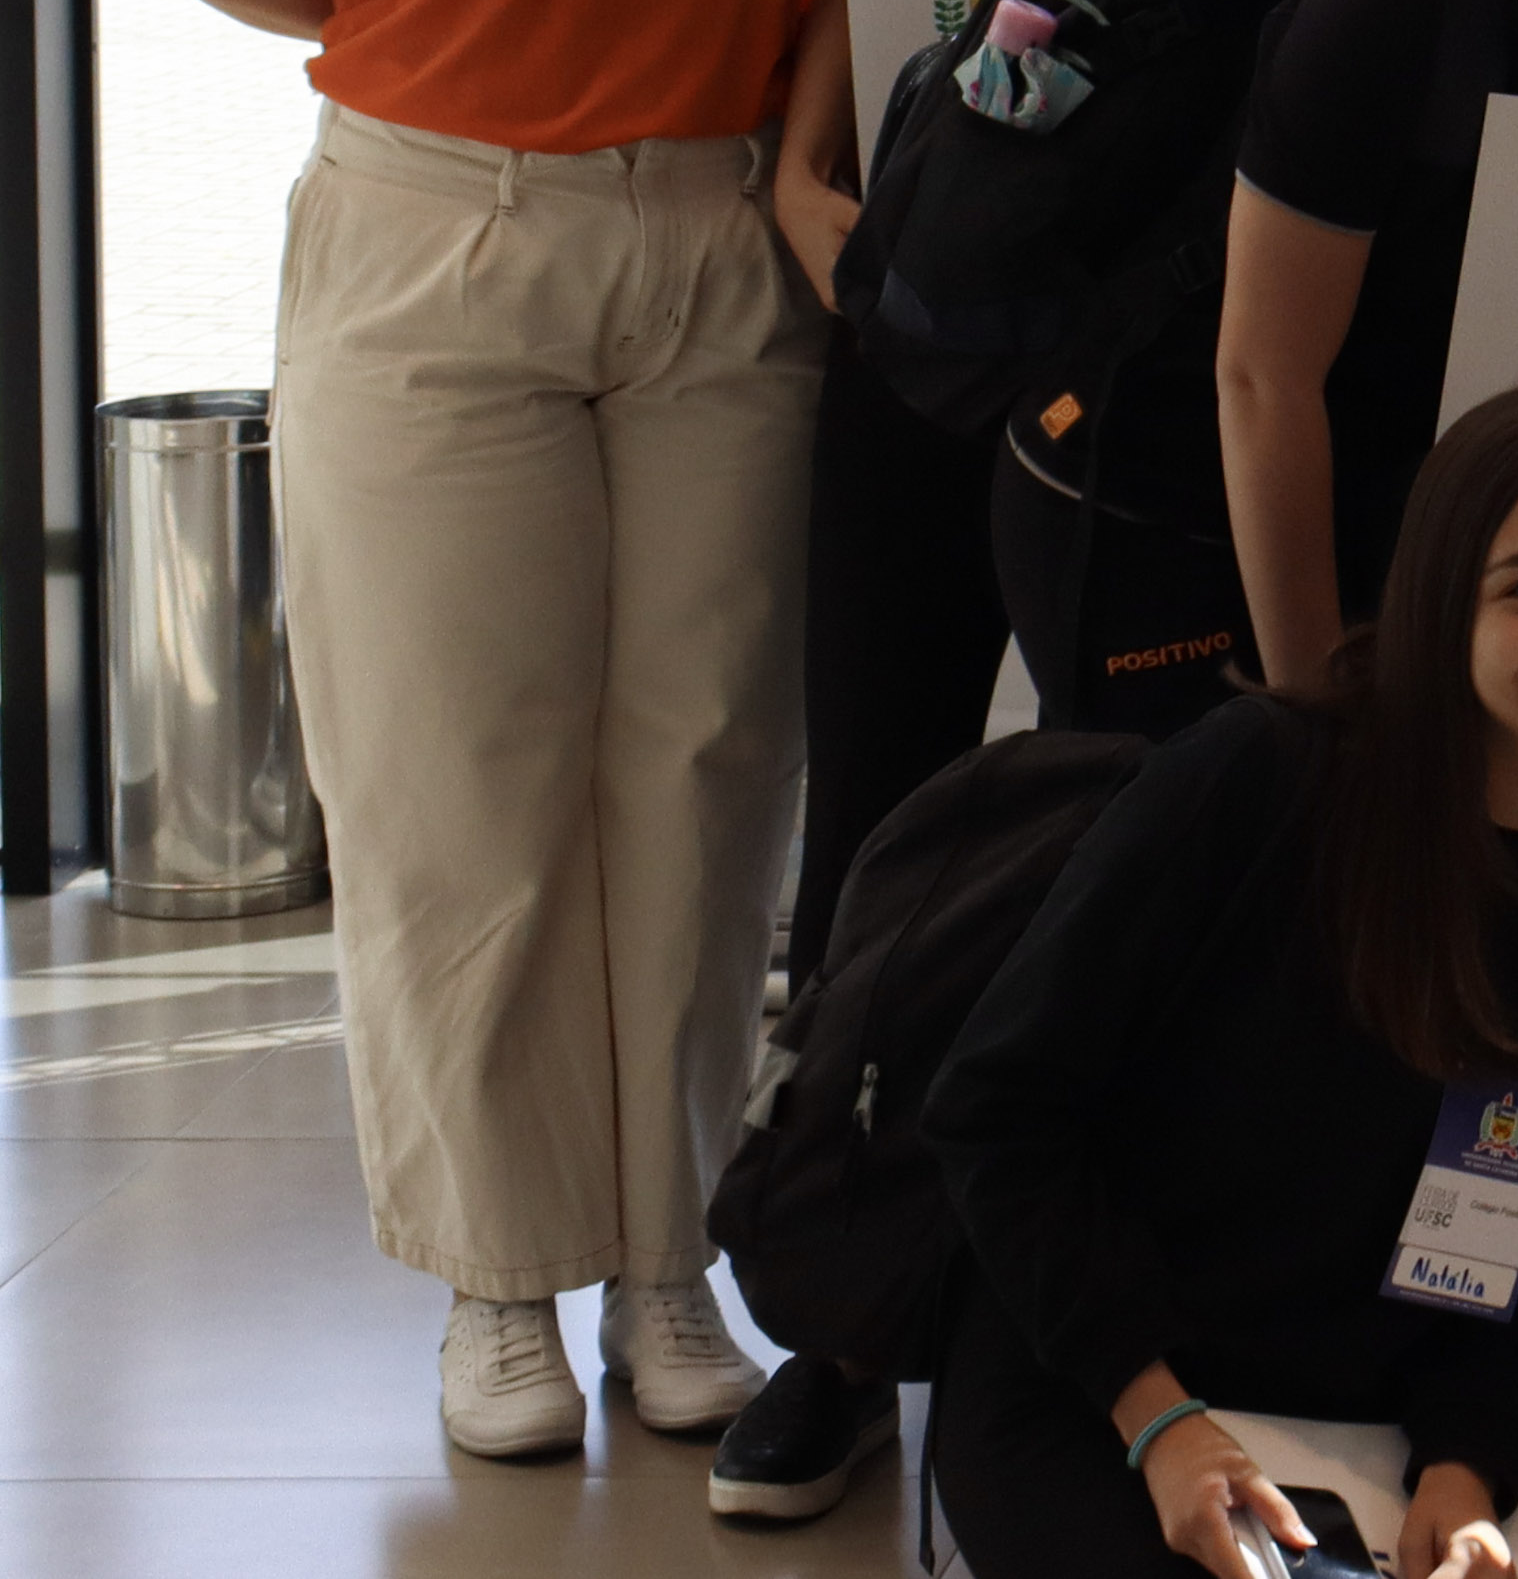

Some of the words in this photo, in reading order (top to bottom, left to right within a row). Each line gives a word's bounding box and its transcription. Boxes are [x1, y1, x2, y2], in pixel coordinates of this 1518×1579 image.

[1105, 631, 1232, 677] POSITIVO
[1414, 1207, 1453, 1228] UFSC
[1410, 1256, 1486, 1298] Natália
